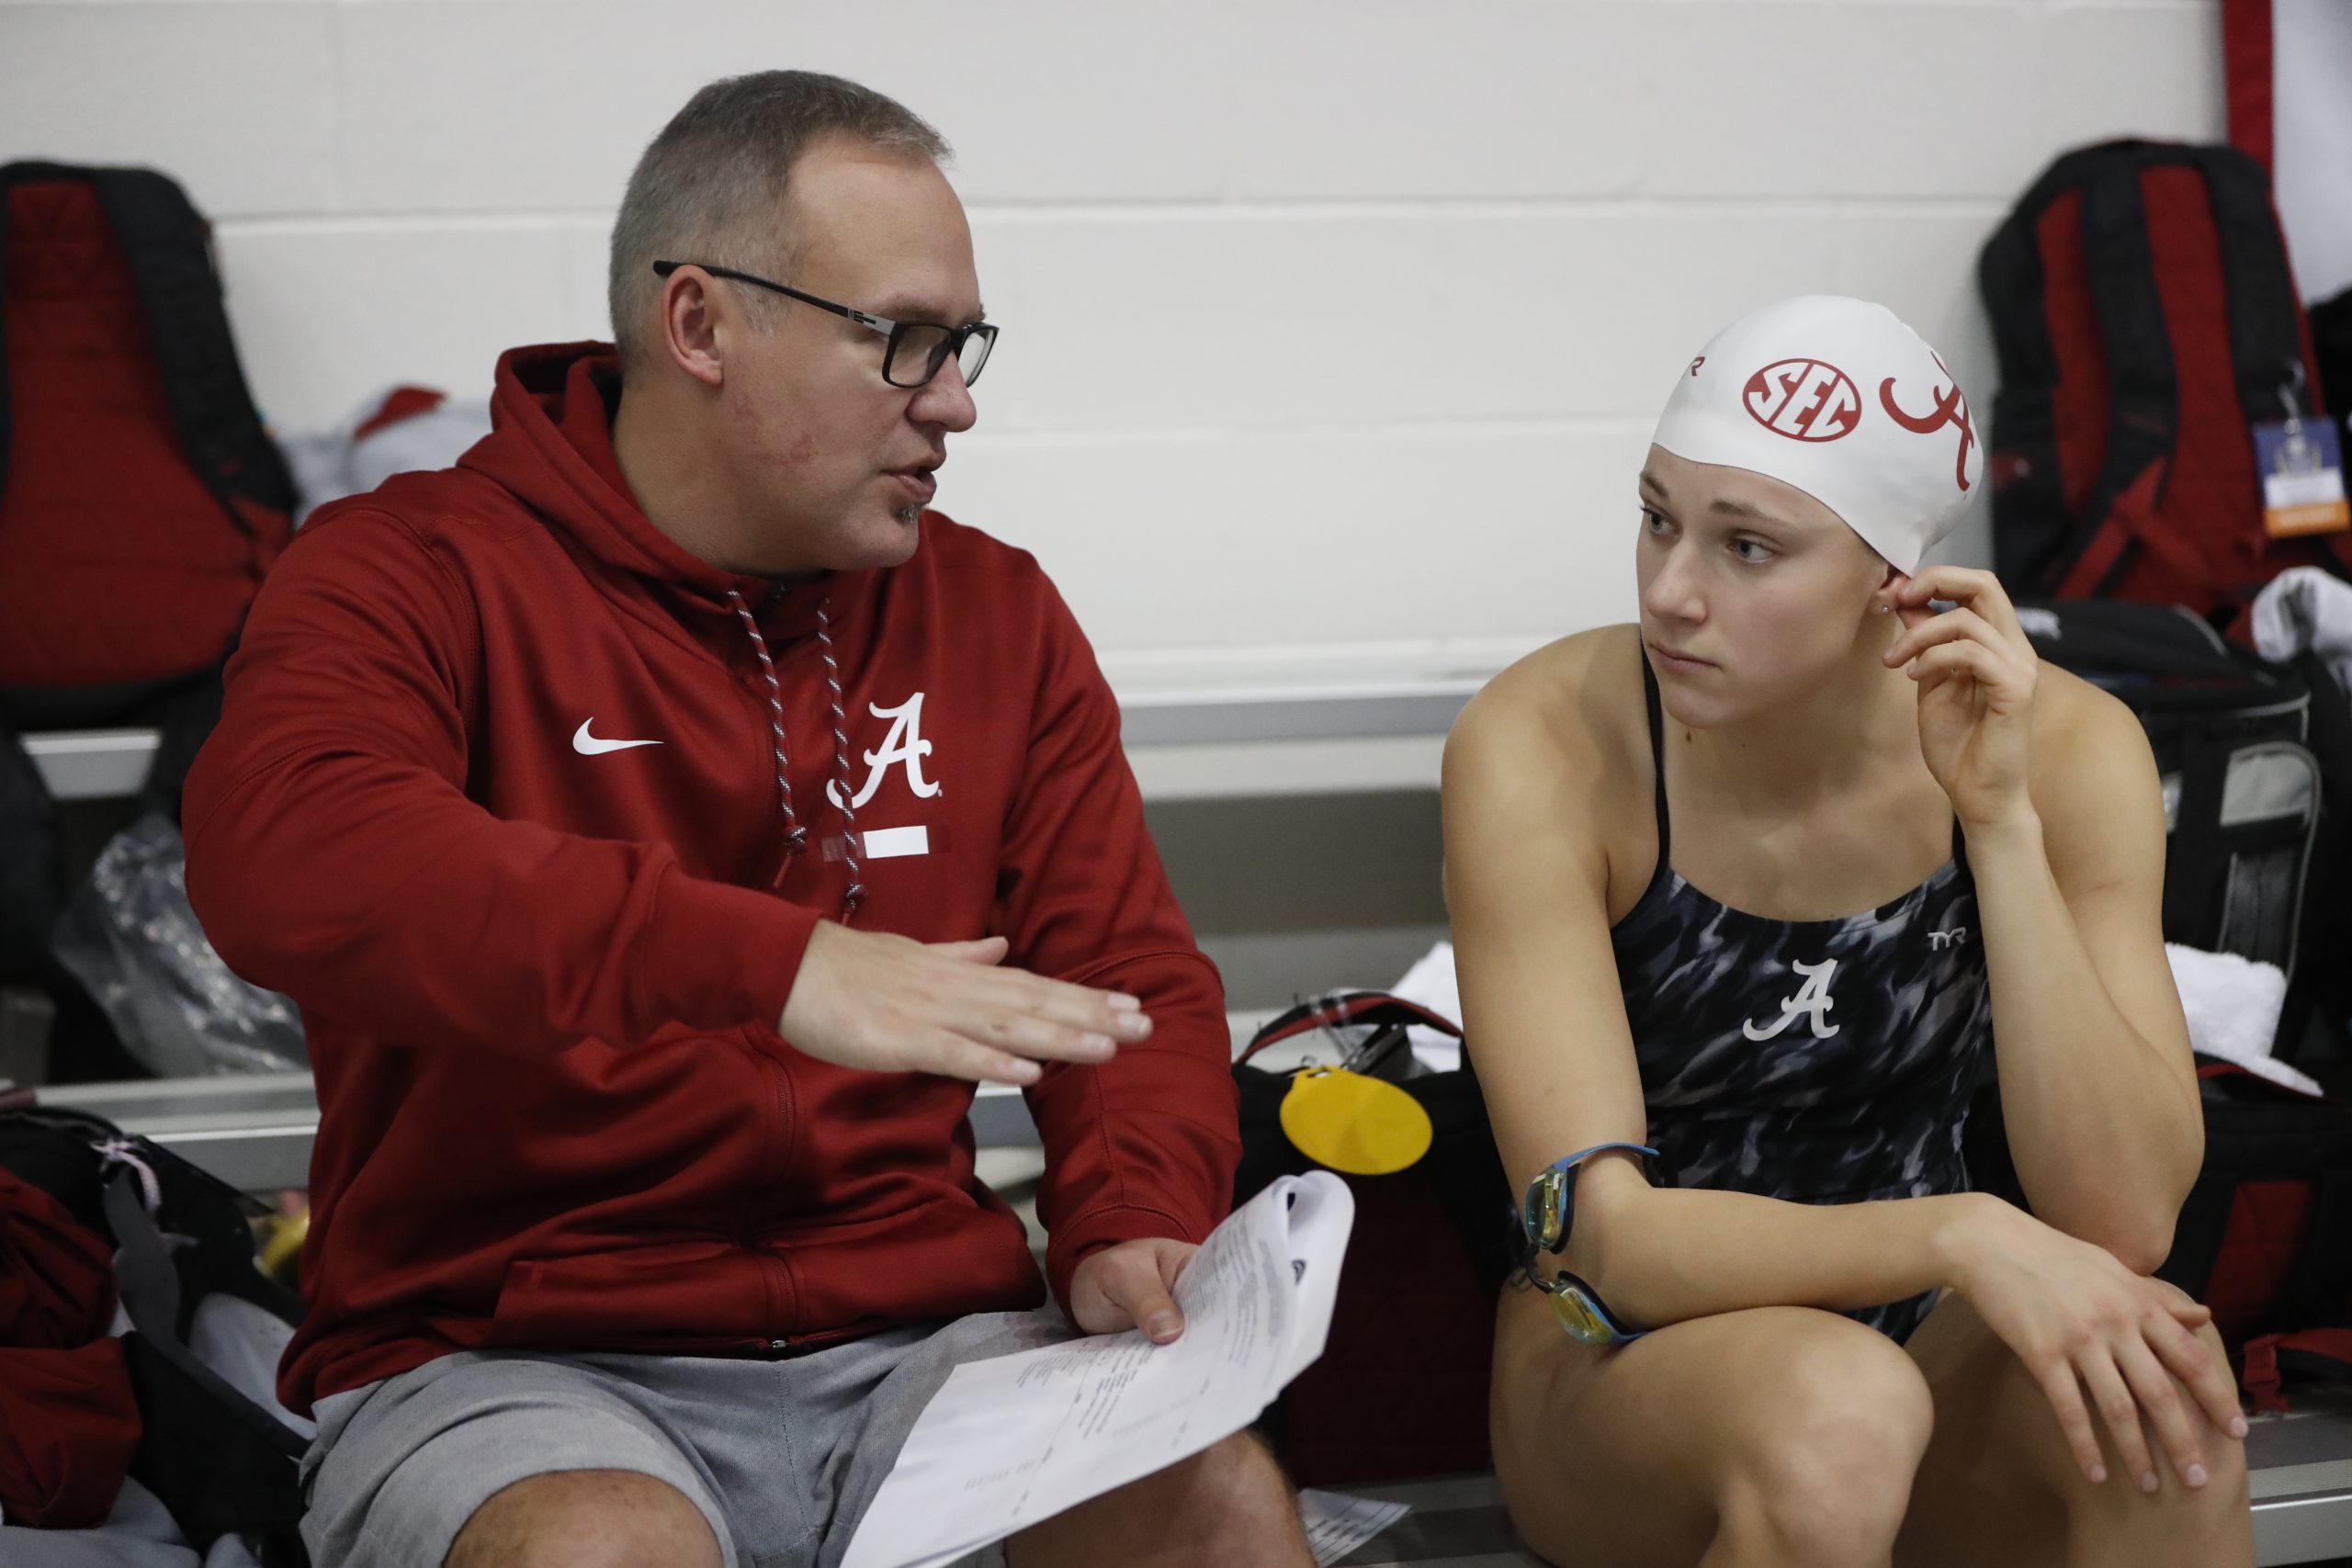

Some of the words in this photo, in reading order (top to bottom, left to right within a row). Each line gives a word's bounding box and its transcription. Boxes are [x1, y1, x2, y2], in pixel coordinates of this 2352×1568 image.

[1747, 362, 1858, 438] SEC
[826, 692, 939, 809] A
[1928, 927, 1966, 952] TYR
[1743, 958, 1839, 1041] A
